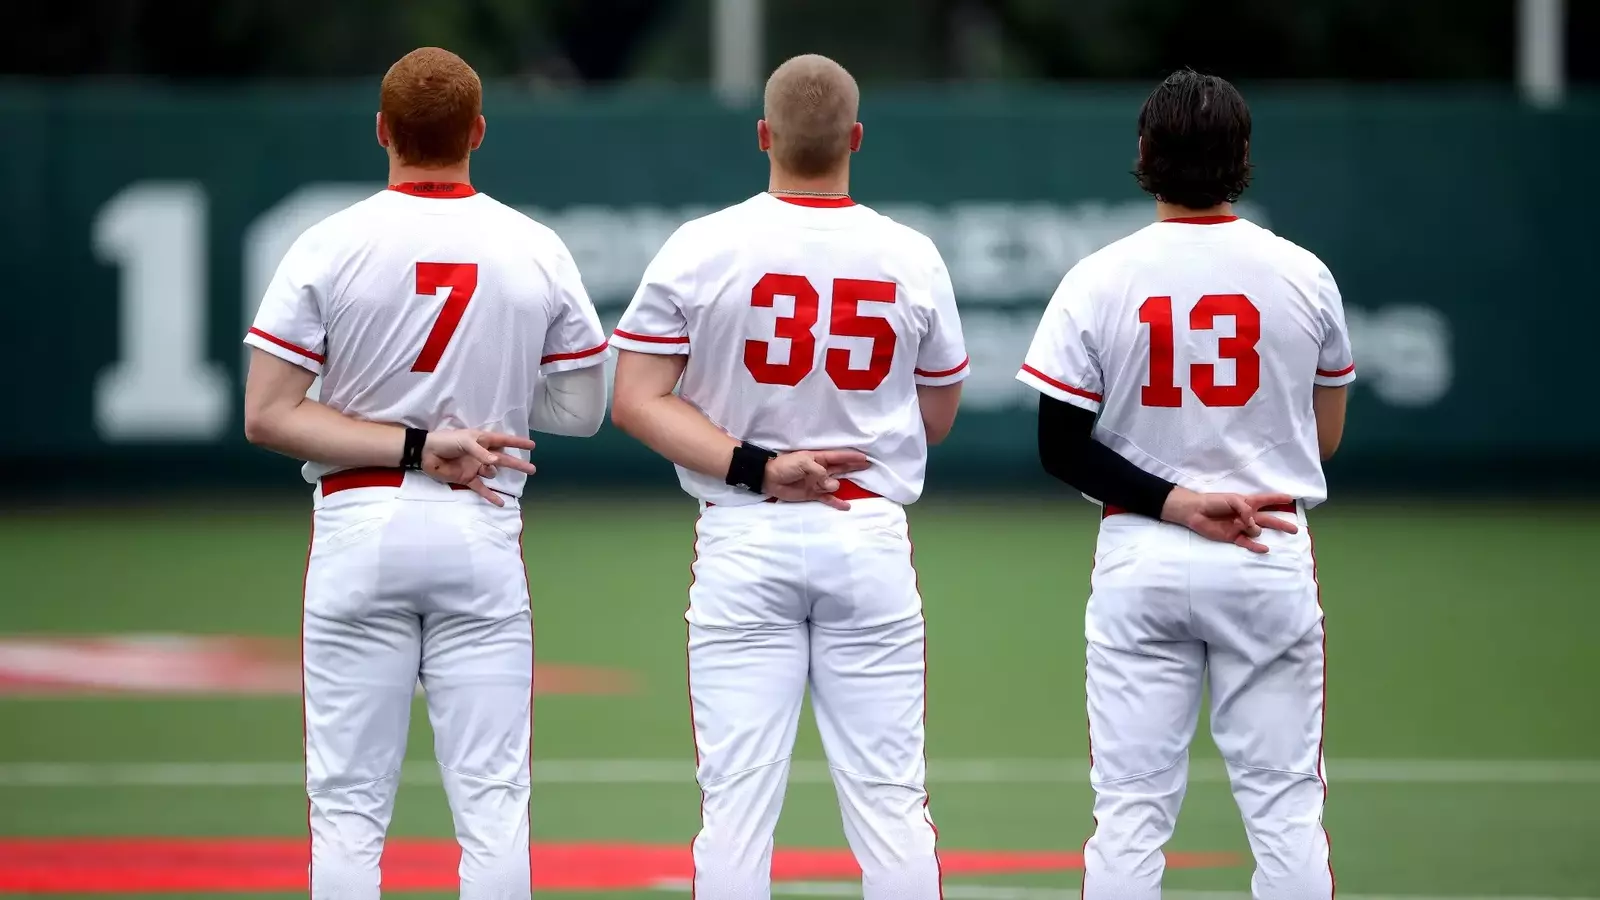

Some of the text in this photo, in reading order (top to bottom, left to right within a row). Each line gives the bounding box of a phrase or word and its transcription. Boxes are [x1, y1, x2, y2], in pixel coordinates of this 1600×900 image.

[410, 262, 478, 373] 7
[743, 272, 898, 391] 35
[1138, 294, 1261, 408] 13
